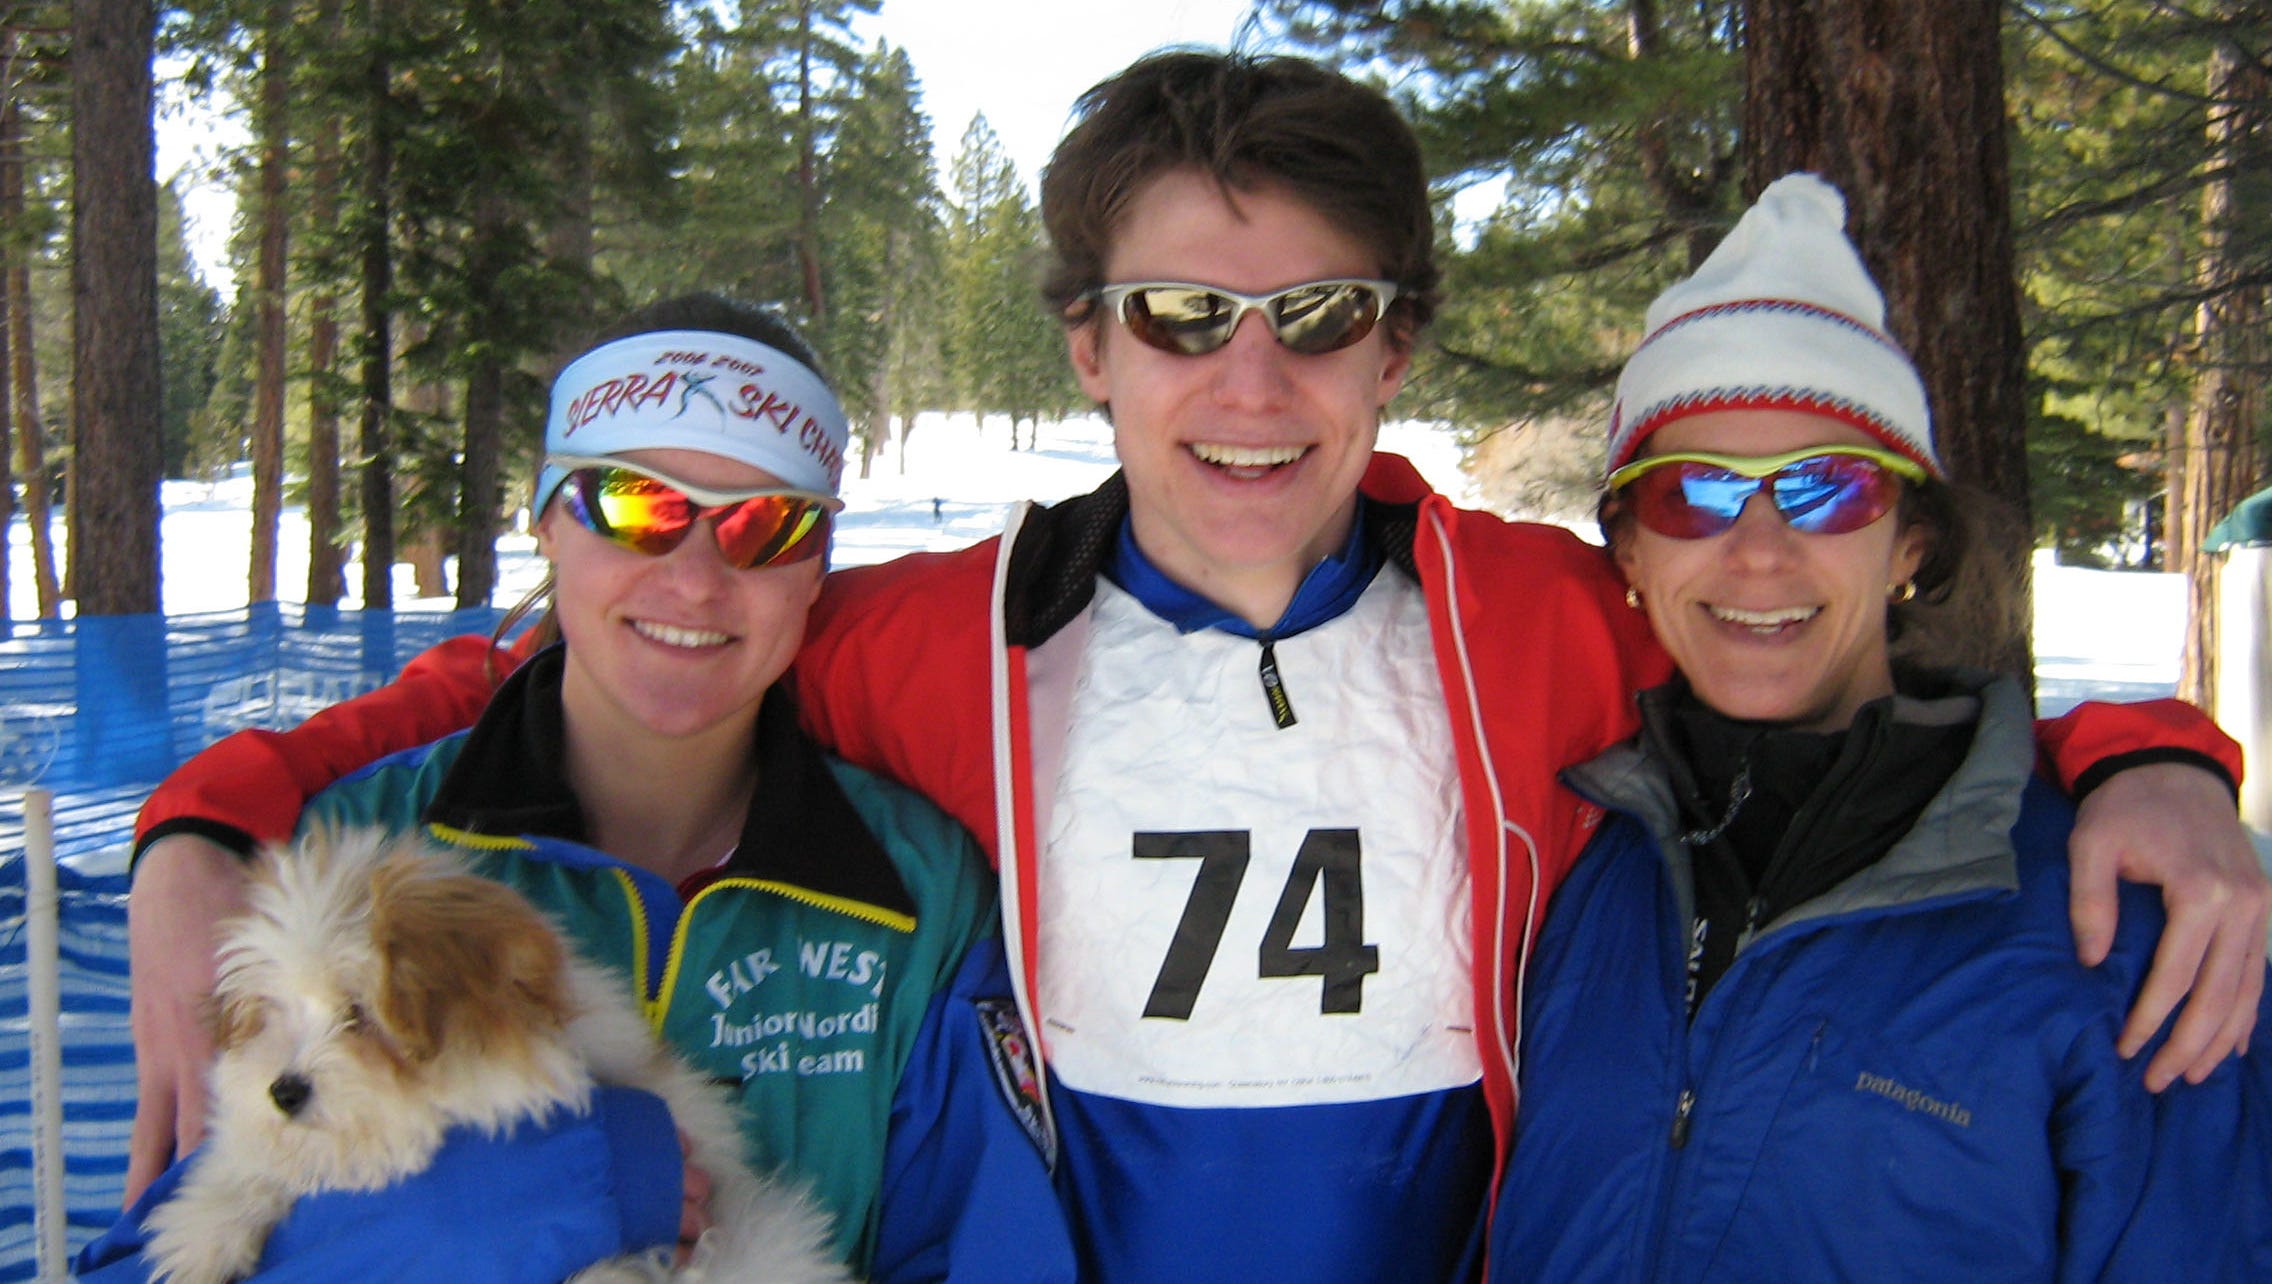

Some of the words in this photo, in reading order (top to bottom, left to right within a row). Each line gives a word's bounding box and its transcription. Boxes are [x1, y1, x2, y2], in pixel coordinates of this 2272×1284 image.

[564, 370, 678, 438] SIERRA
[728, 382, 801, 434] SKI
[799, 416, 843, 486] CHA
[1132, 827, 1379, 1020] 74
[710, 1011, 799, 1048] Junior
[799, 1002, 879, 1040] Nordi
[796, 1049, 865, 1075] eam
[1856, 1072, 1970, 1128] patagonia
